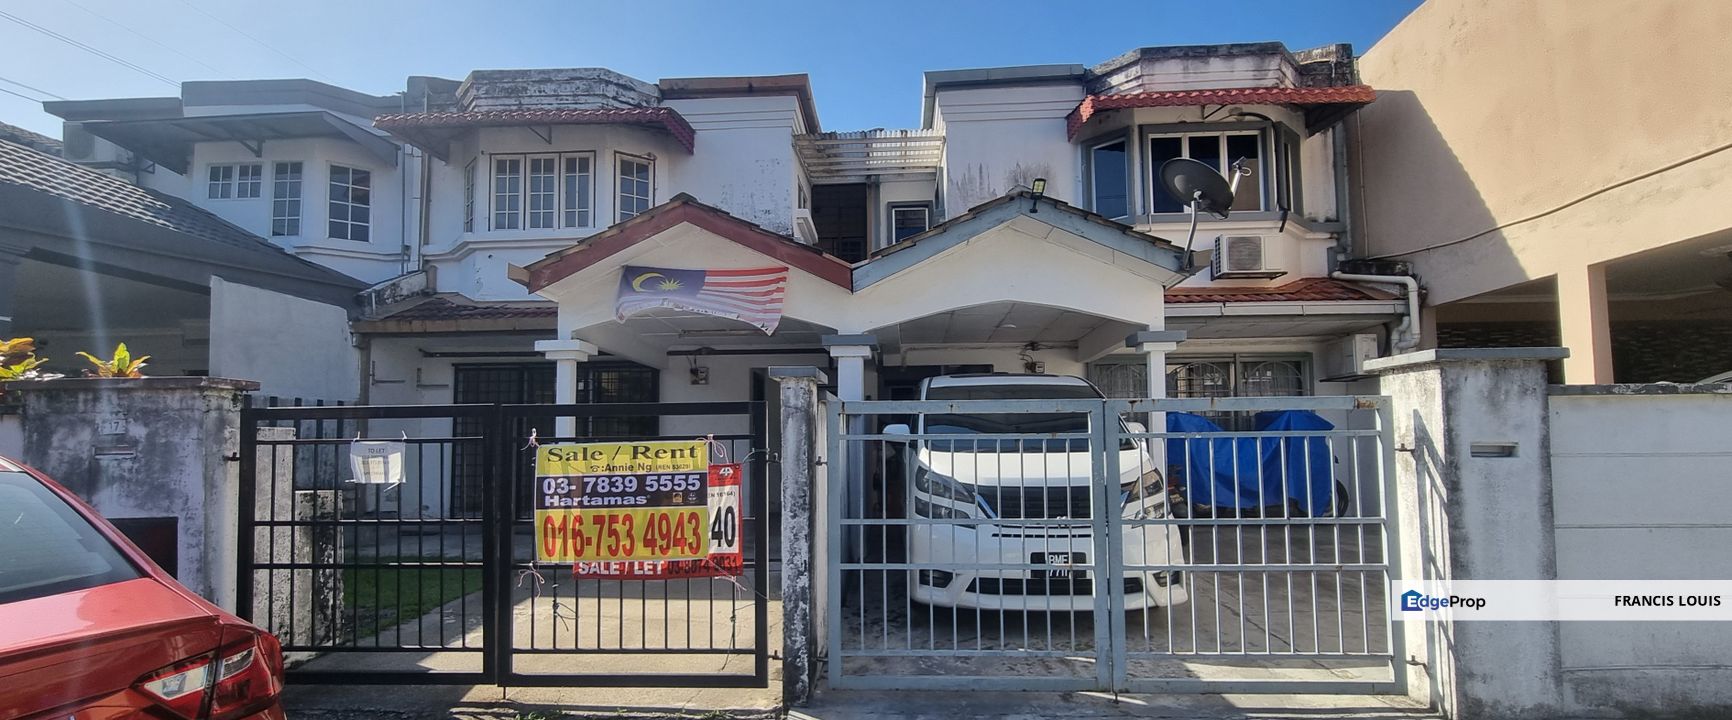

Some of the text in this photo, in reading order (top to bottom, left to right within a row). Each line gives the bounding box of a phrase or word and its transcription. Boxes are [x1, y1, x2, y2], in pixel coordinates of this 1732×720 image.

[547, 444, 698, 463] Sale / Rent
[637, 462, 652, 473] Ng
[542, 474, 700, 494] 03- 7839 5555
[544, 495, 648, 507] Hartamas
[543, 511, 702, 558] 016-753 4943
[707, 505, 736, 548] 40
[578, 561, 621, 575] SALE
[623, 561, 629, 575] /
[633, 560, 665, 575] LET
